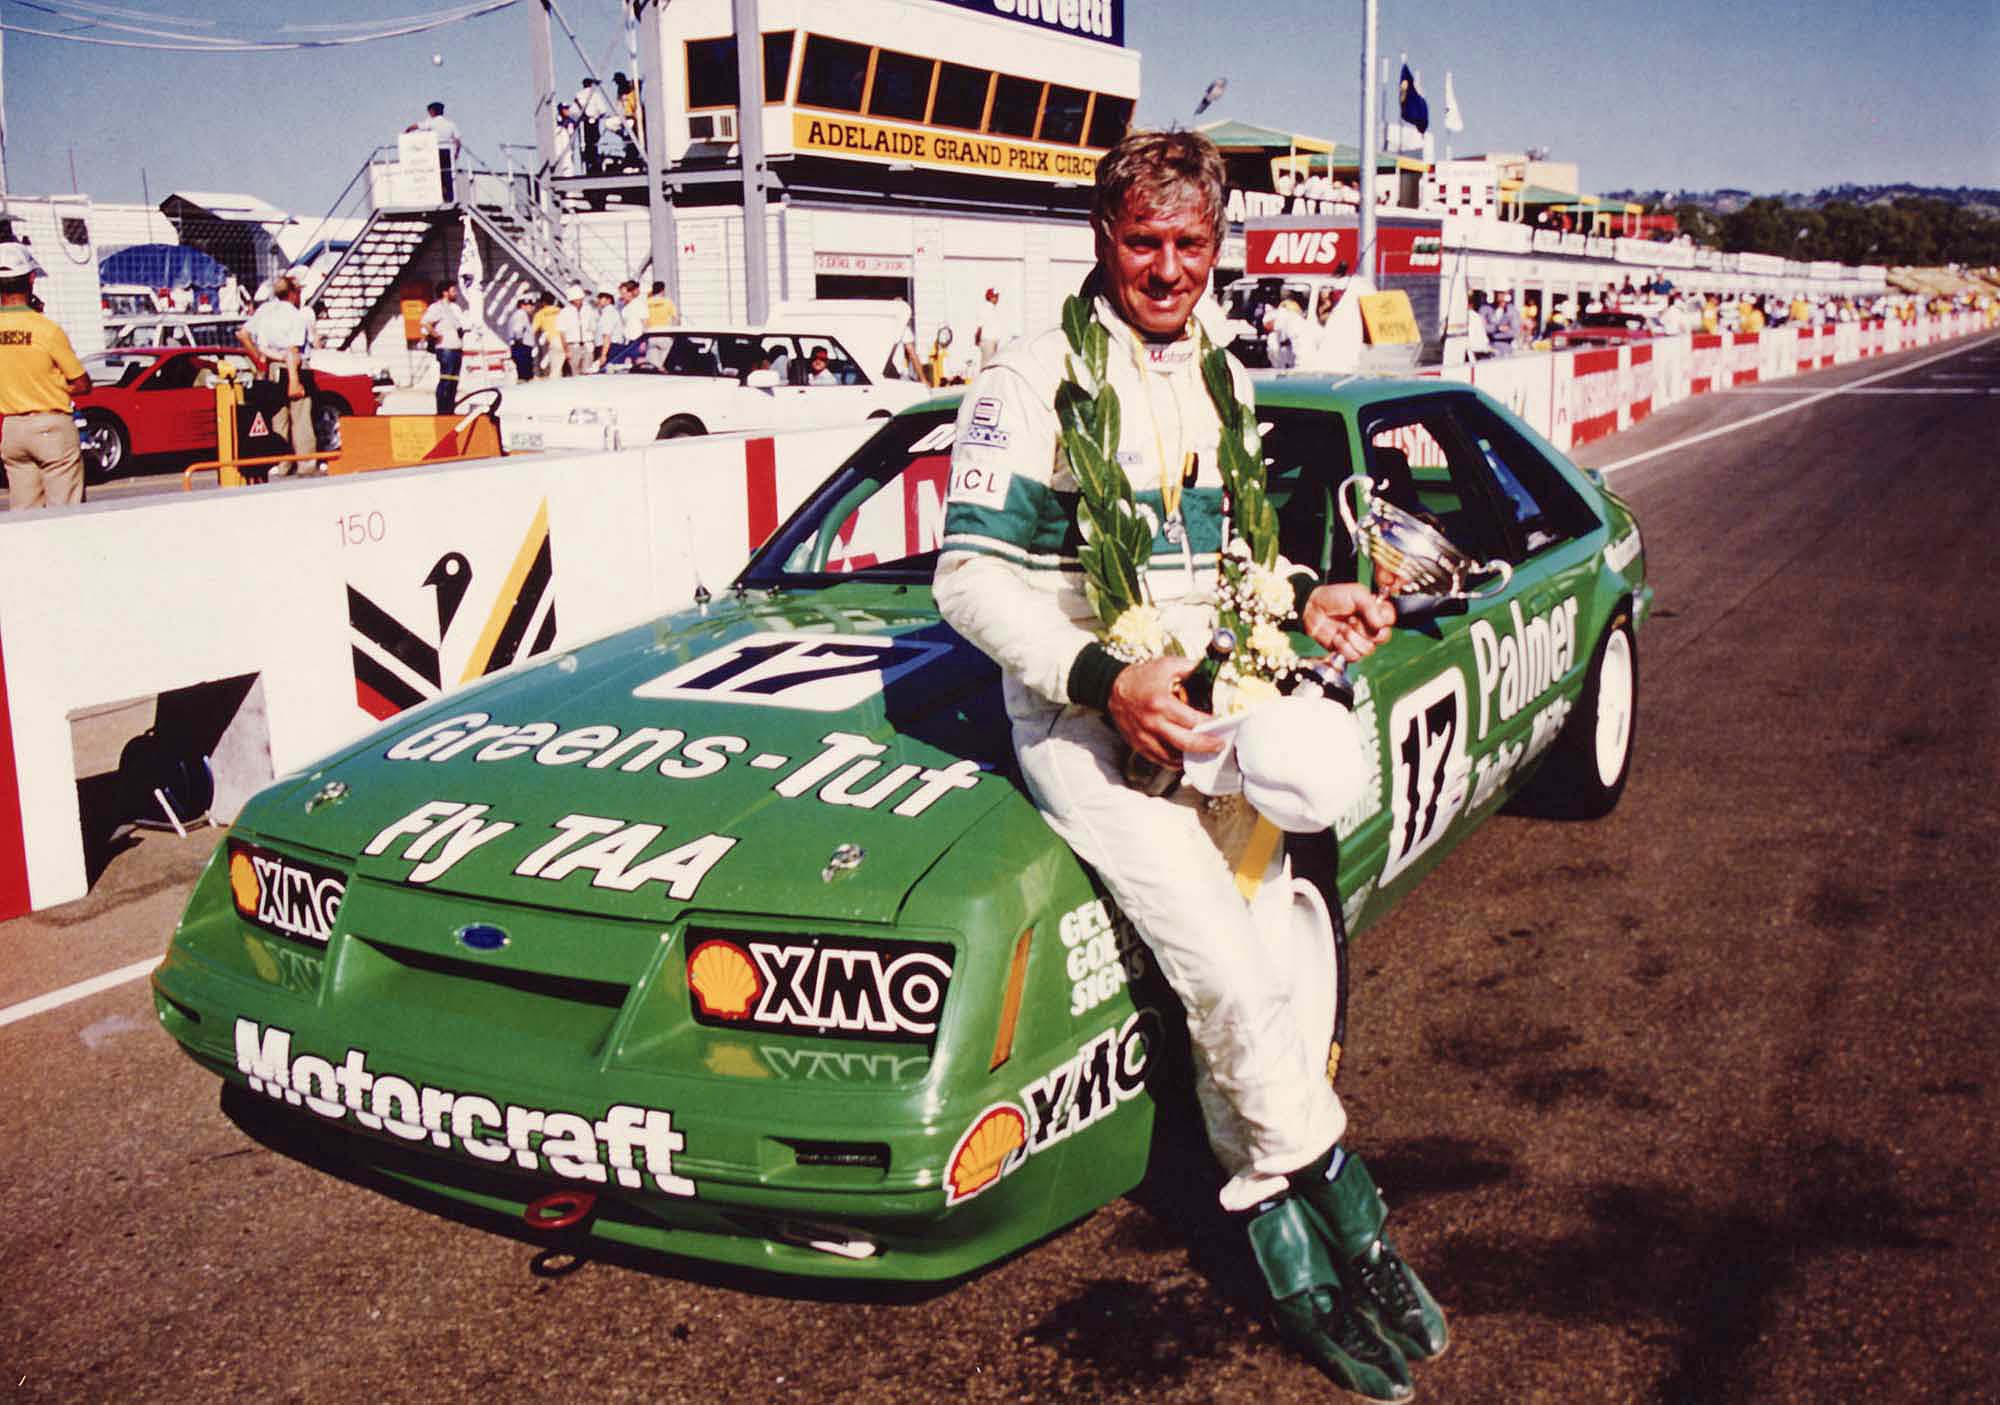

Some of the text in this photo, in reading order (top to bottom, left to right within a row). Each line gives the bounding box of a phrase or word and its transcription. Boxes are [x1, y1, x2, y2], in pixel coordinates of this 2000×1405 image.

[808, 120, 1097, 176] ADELAIDE GRAND PRIX CIRC
[1265, 231, 1340, 265] AVIS
[336, 511, 385, 547] 150
[676, 640, 935, 695] 17
[1469, 596, 1579, 741] Palmer
[384, 711, 982, 818] Greens-Tuf
[1400, 690, 1458, 860] 17
[362, 800, 742, 902] Fly TAA
[747, 942, 953, 1034] XMO
[233, 1015, 697, 1198] Motorcraft
